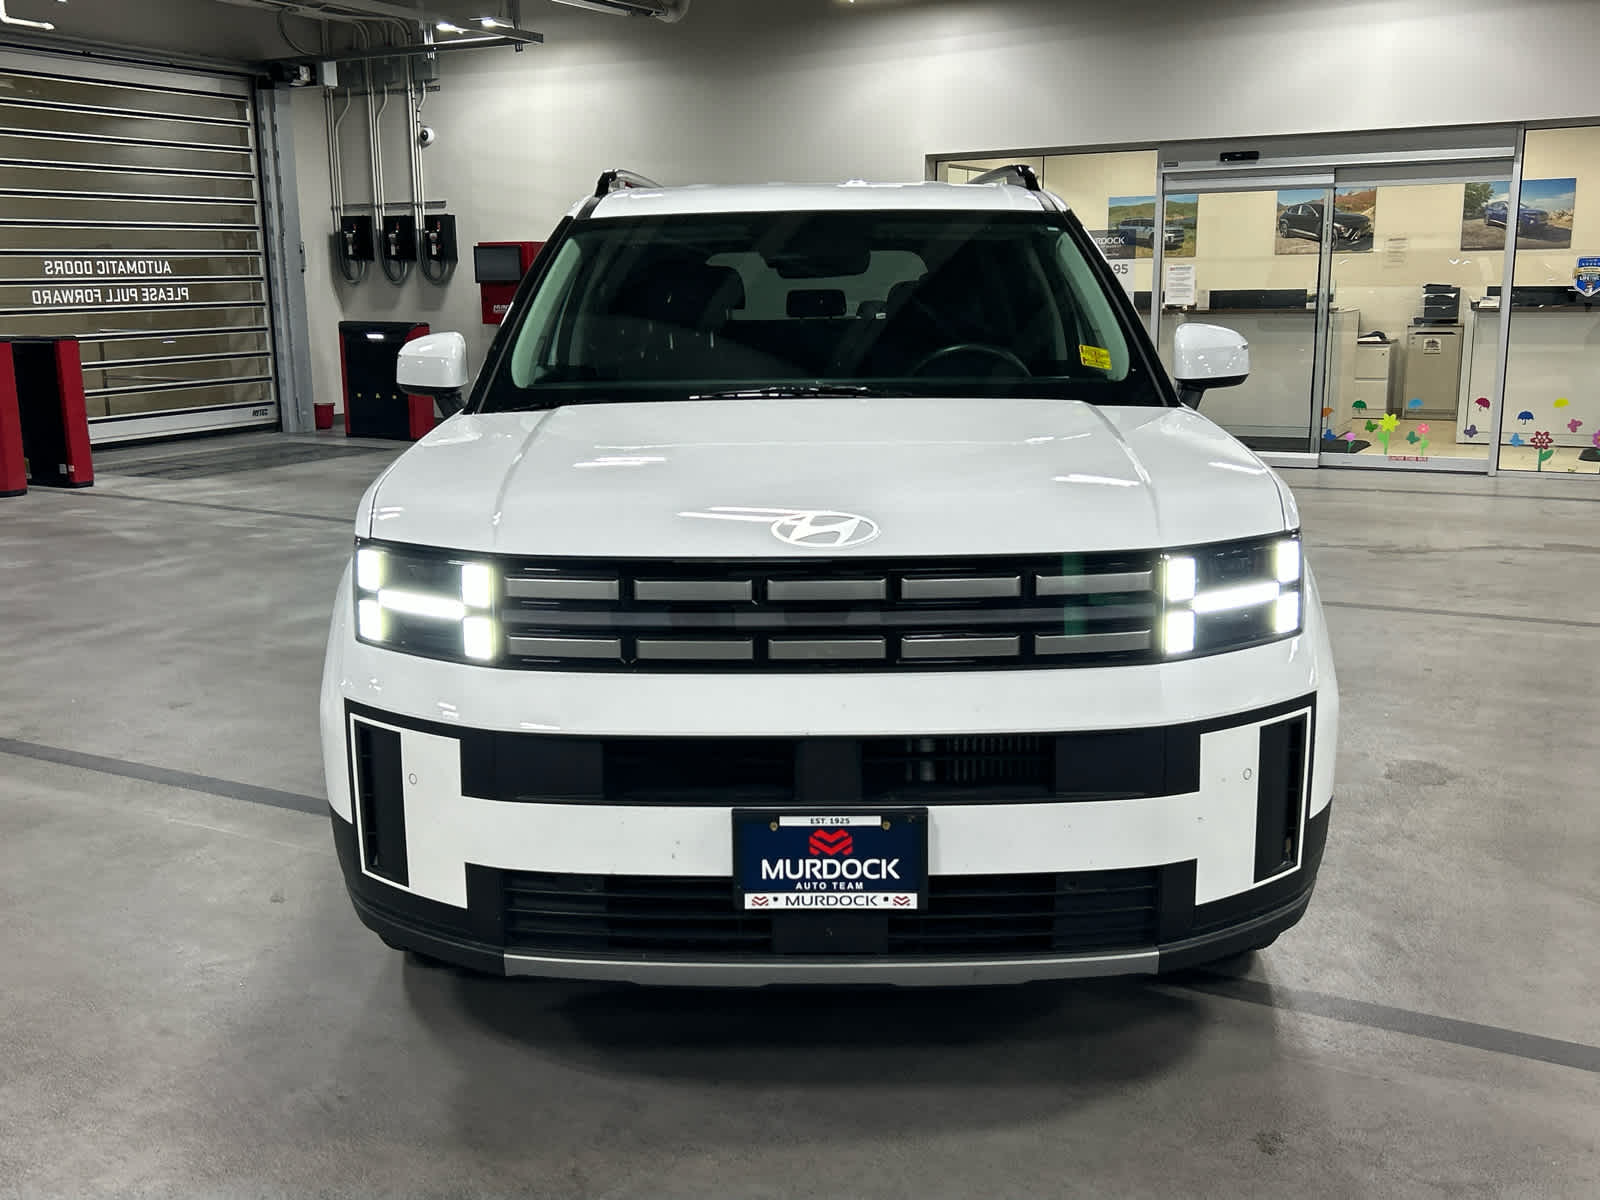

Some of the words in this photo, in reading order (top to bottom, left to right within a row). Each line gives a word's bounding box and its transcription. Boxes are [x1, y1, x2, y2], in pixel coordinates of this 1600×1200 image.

[810, 816, 827, 825] EST.
[829, 816, 851, 825] 1925
[761, 858, 900, 880] MURDOCK
[795, 881, 827, 890] AUTO
[831, 881, 864, 890] TEAM
[785, 895, 878, 907] MURDOCK
